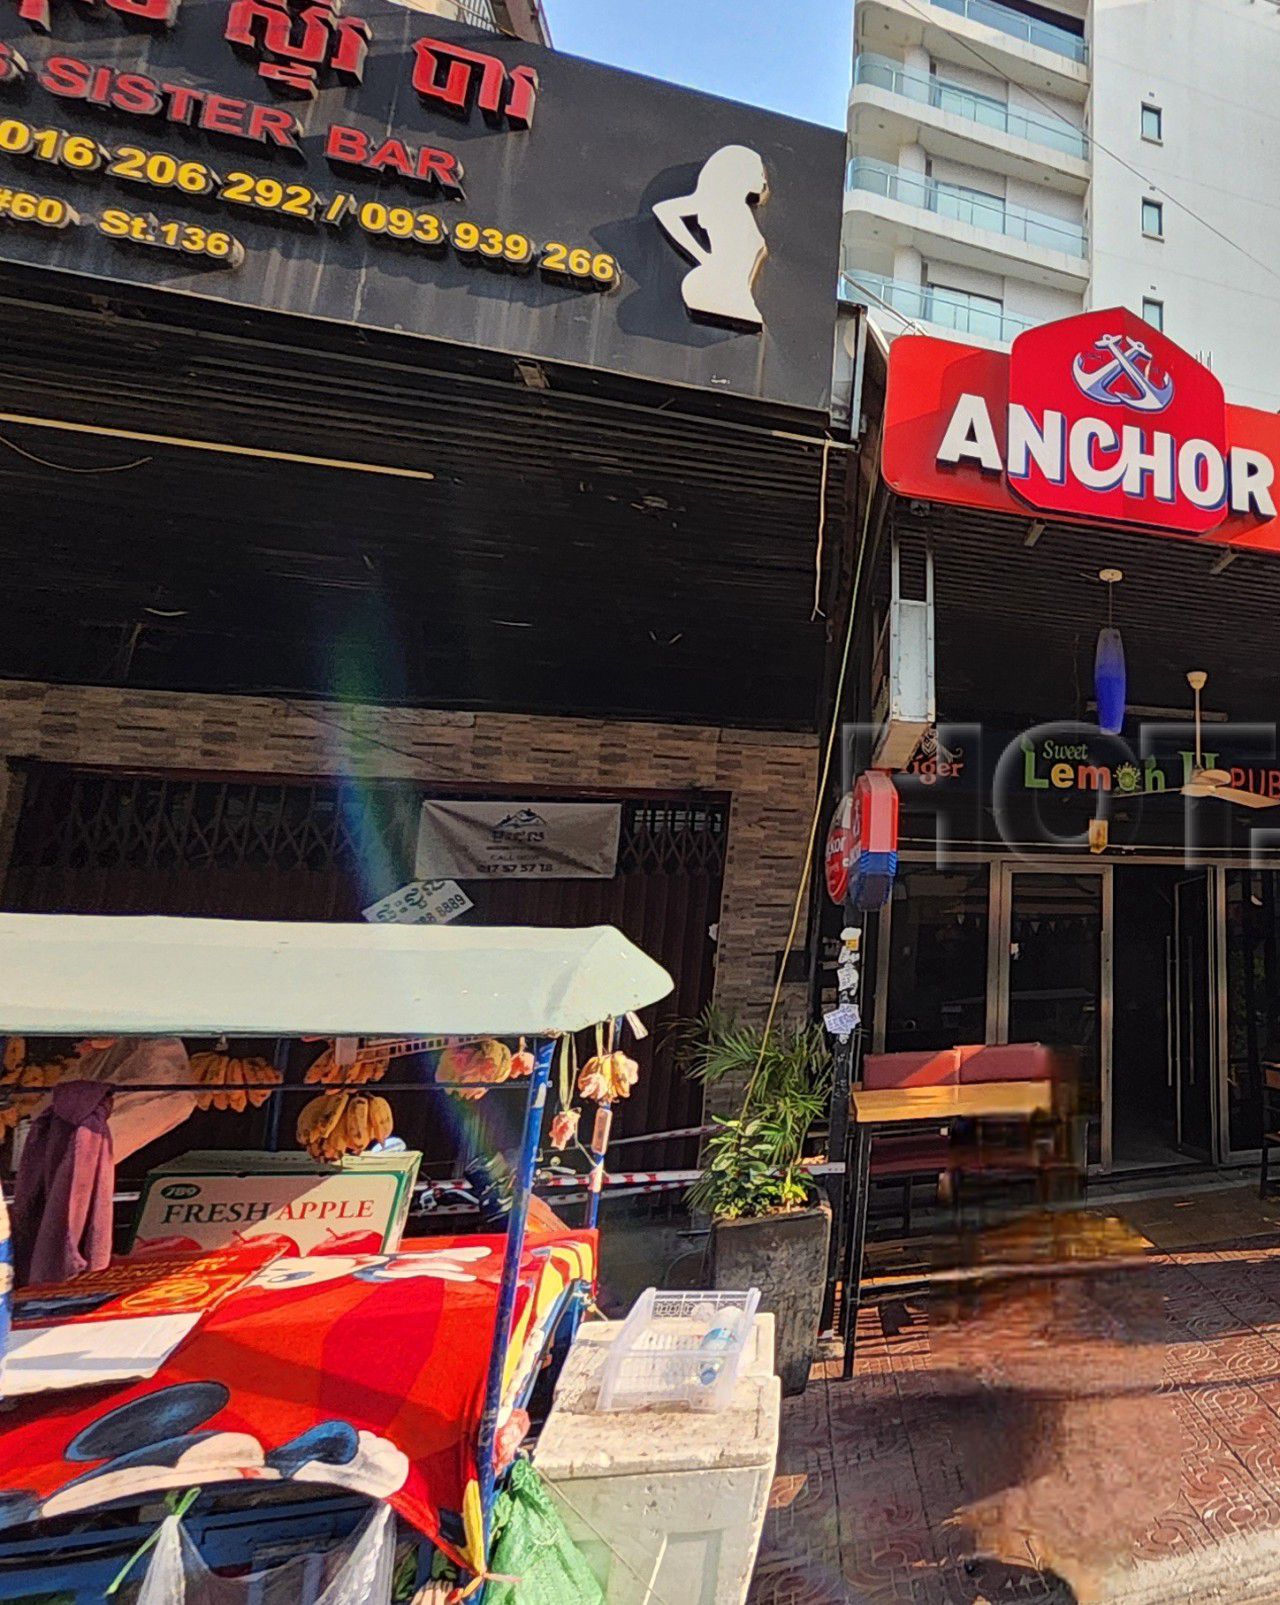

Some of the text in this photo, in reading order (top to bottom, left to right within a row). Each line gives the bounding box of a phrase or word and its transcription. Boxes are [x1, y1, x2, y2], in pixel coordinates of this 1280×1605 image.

[40, 56, 297, 147] SISTER
[327, 126, 458, 184] BAR
[0, 120, 96, 167] 016
[110, 147, 208, 191] 206
[222, 172, 312, 216] 292
[360, 202, 440, 241] 093
[454, 222, 530, 260] 939
[541, 243, 614, 280] 266
[98, 209, 230, 255] St.136
[936, 393, 1278, 516] ANCHOR
[905, 754, 964, 785] iger
[1043, 740, 1089, 760] Sweet
[160, 1200, 375, 1225] FRESH APPLE
